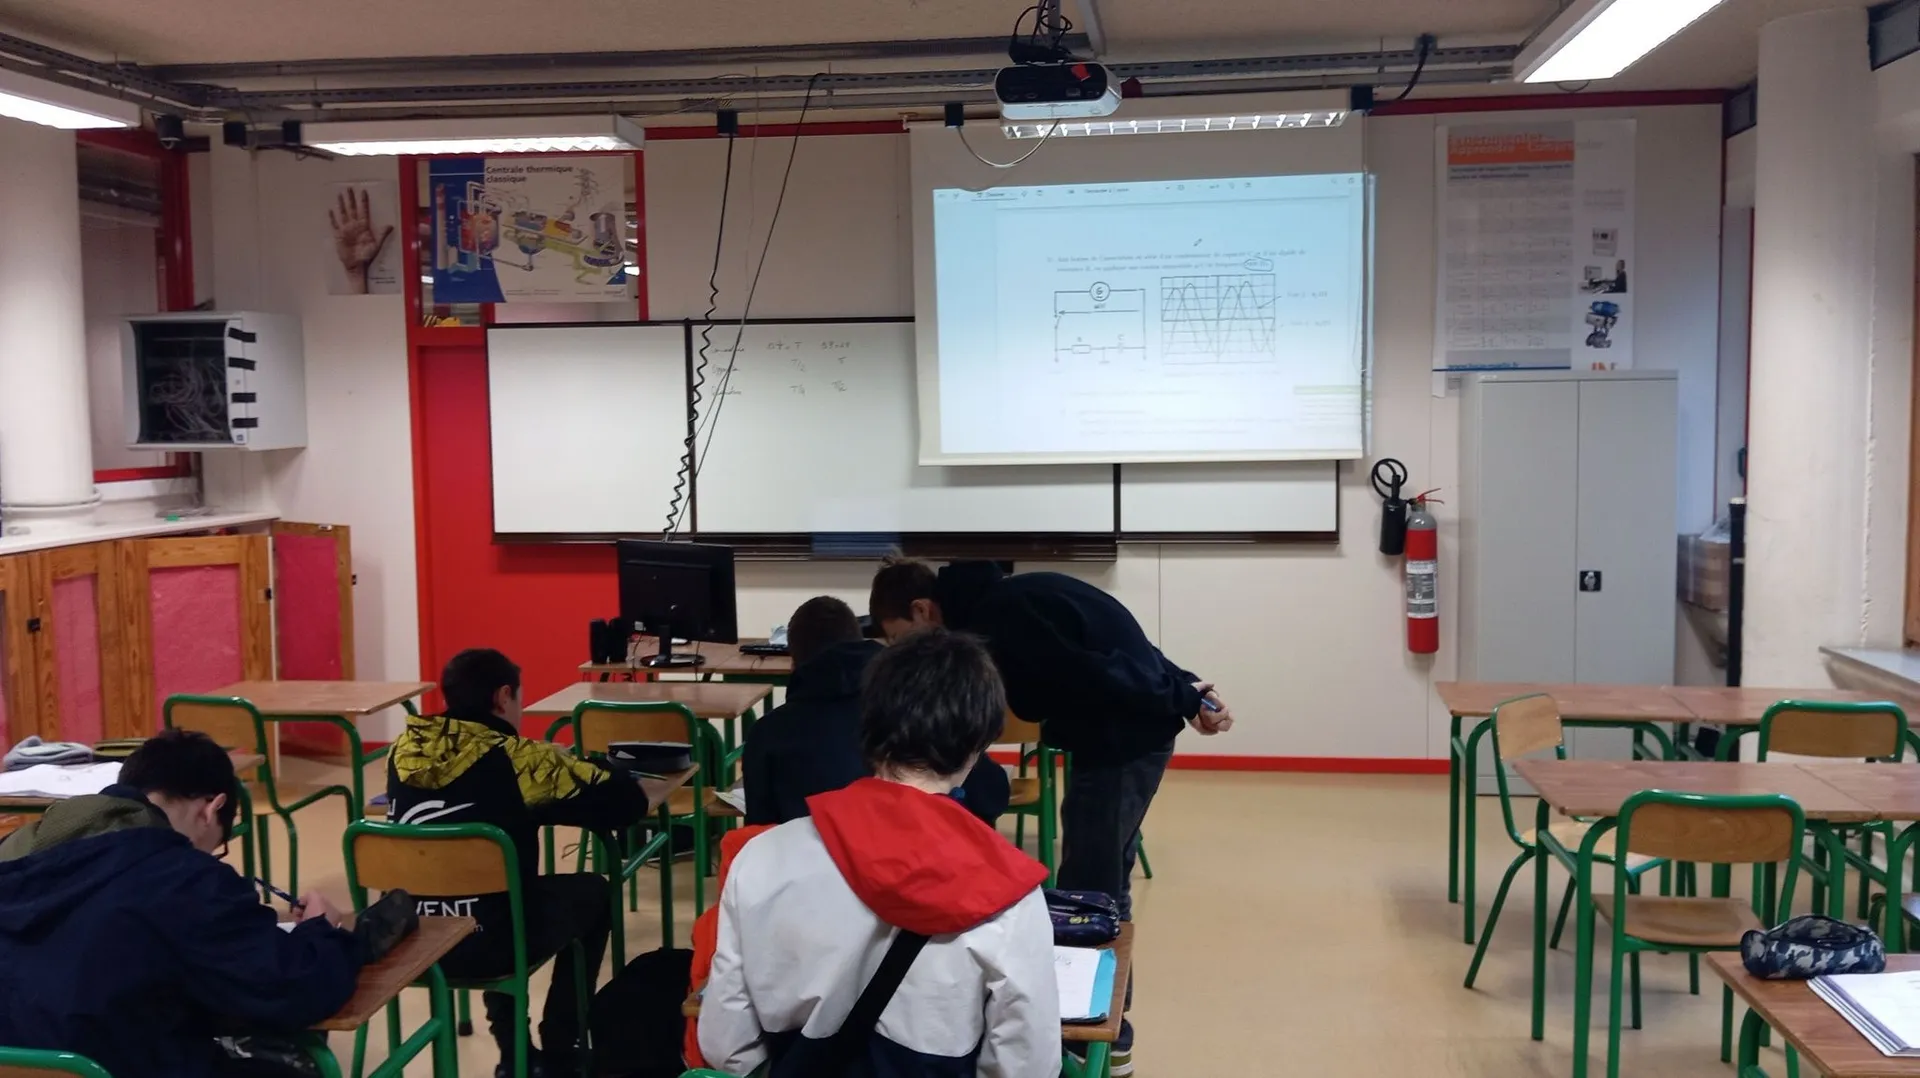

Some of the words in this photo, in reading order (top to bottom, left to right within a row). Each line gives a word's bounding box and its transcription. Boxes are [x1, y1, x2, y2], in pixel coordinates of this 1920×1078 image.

[486, 166, 524, 174] Centrale
[526, 165, 573, 175] thermique
[486, 175, 527, 183] classique
